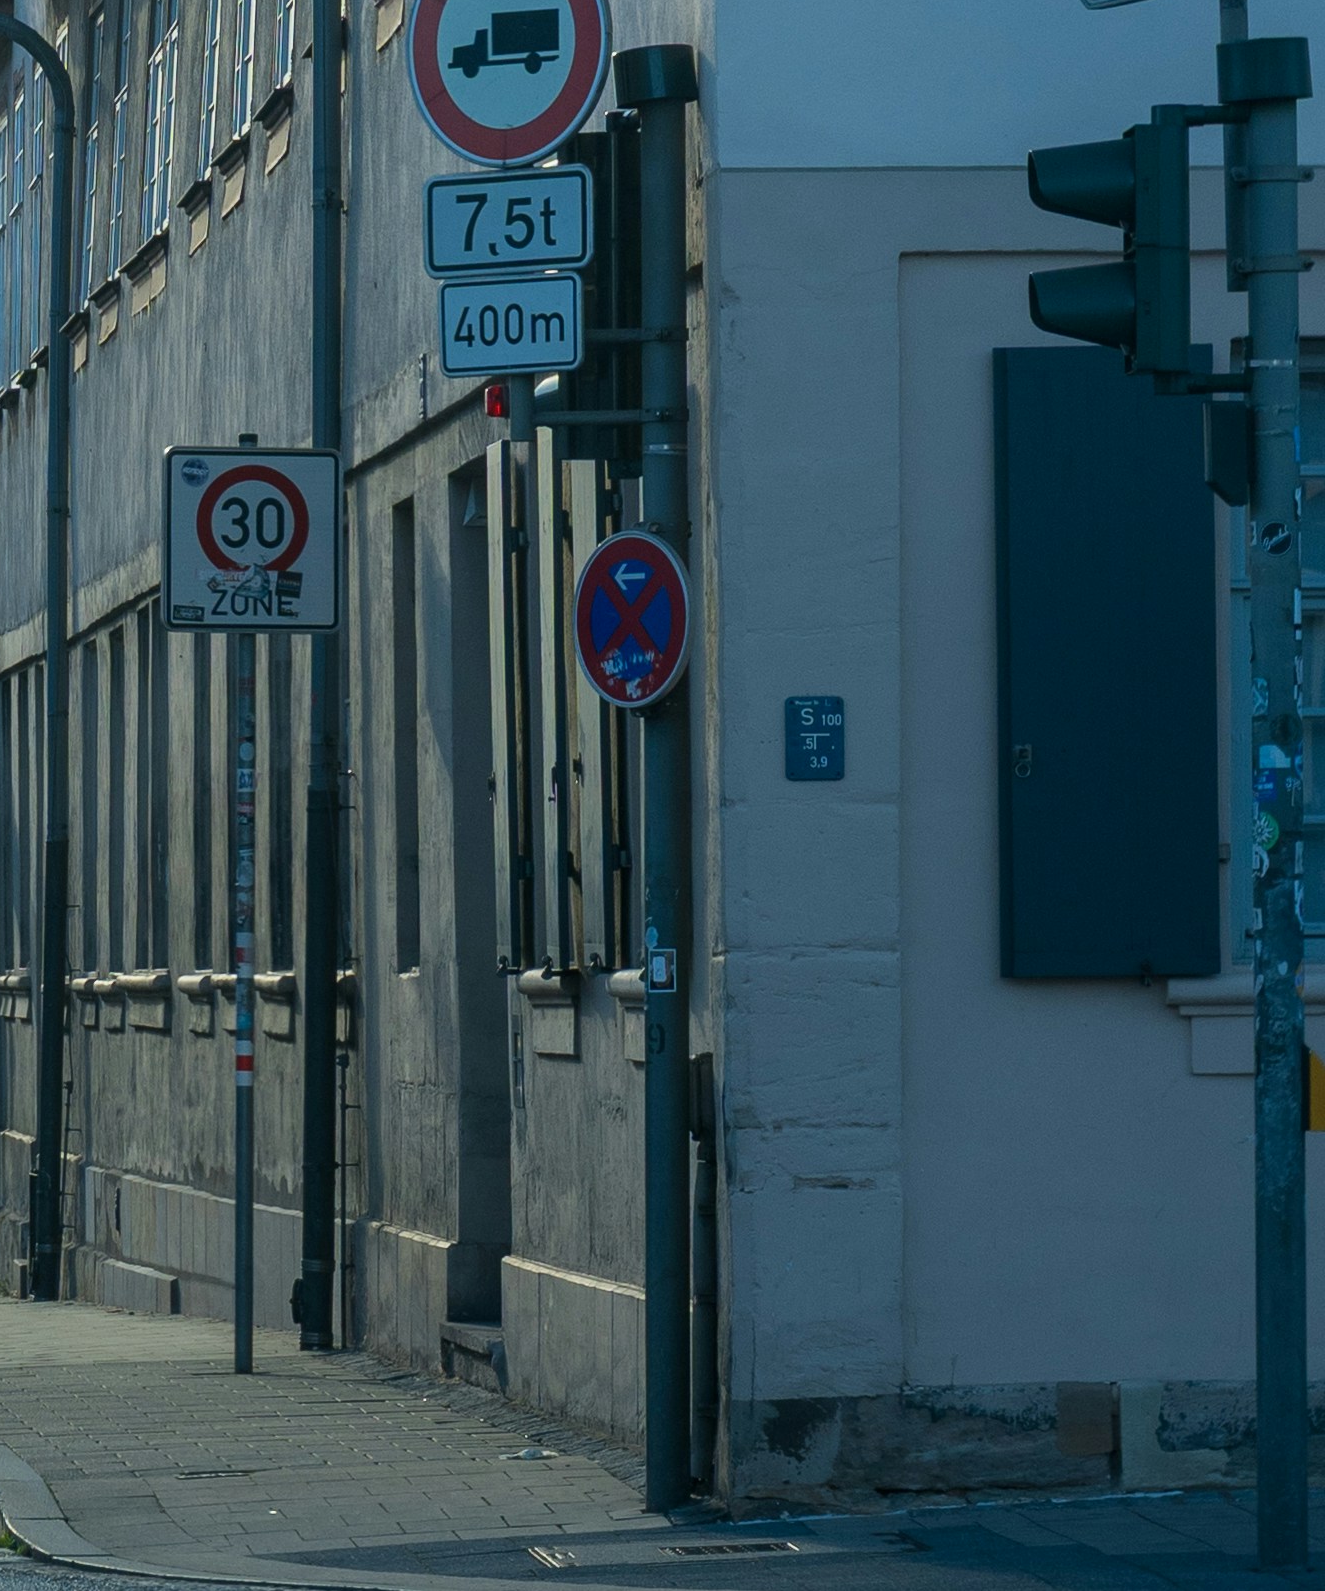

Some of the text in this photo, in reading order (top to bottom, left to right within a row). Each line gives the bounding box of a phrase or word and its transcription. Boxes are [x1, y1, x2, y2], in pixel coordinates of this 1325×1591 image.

[454, 191, 557, 257] 7,5t
[453, 302, 566, 349] 400m
[220, 496, 286, 549] 30
[210, 588, 295, 617] ZONE
[800, 707, 842, 727] S 100
[809, 755, 829, 768] 3,9
